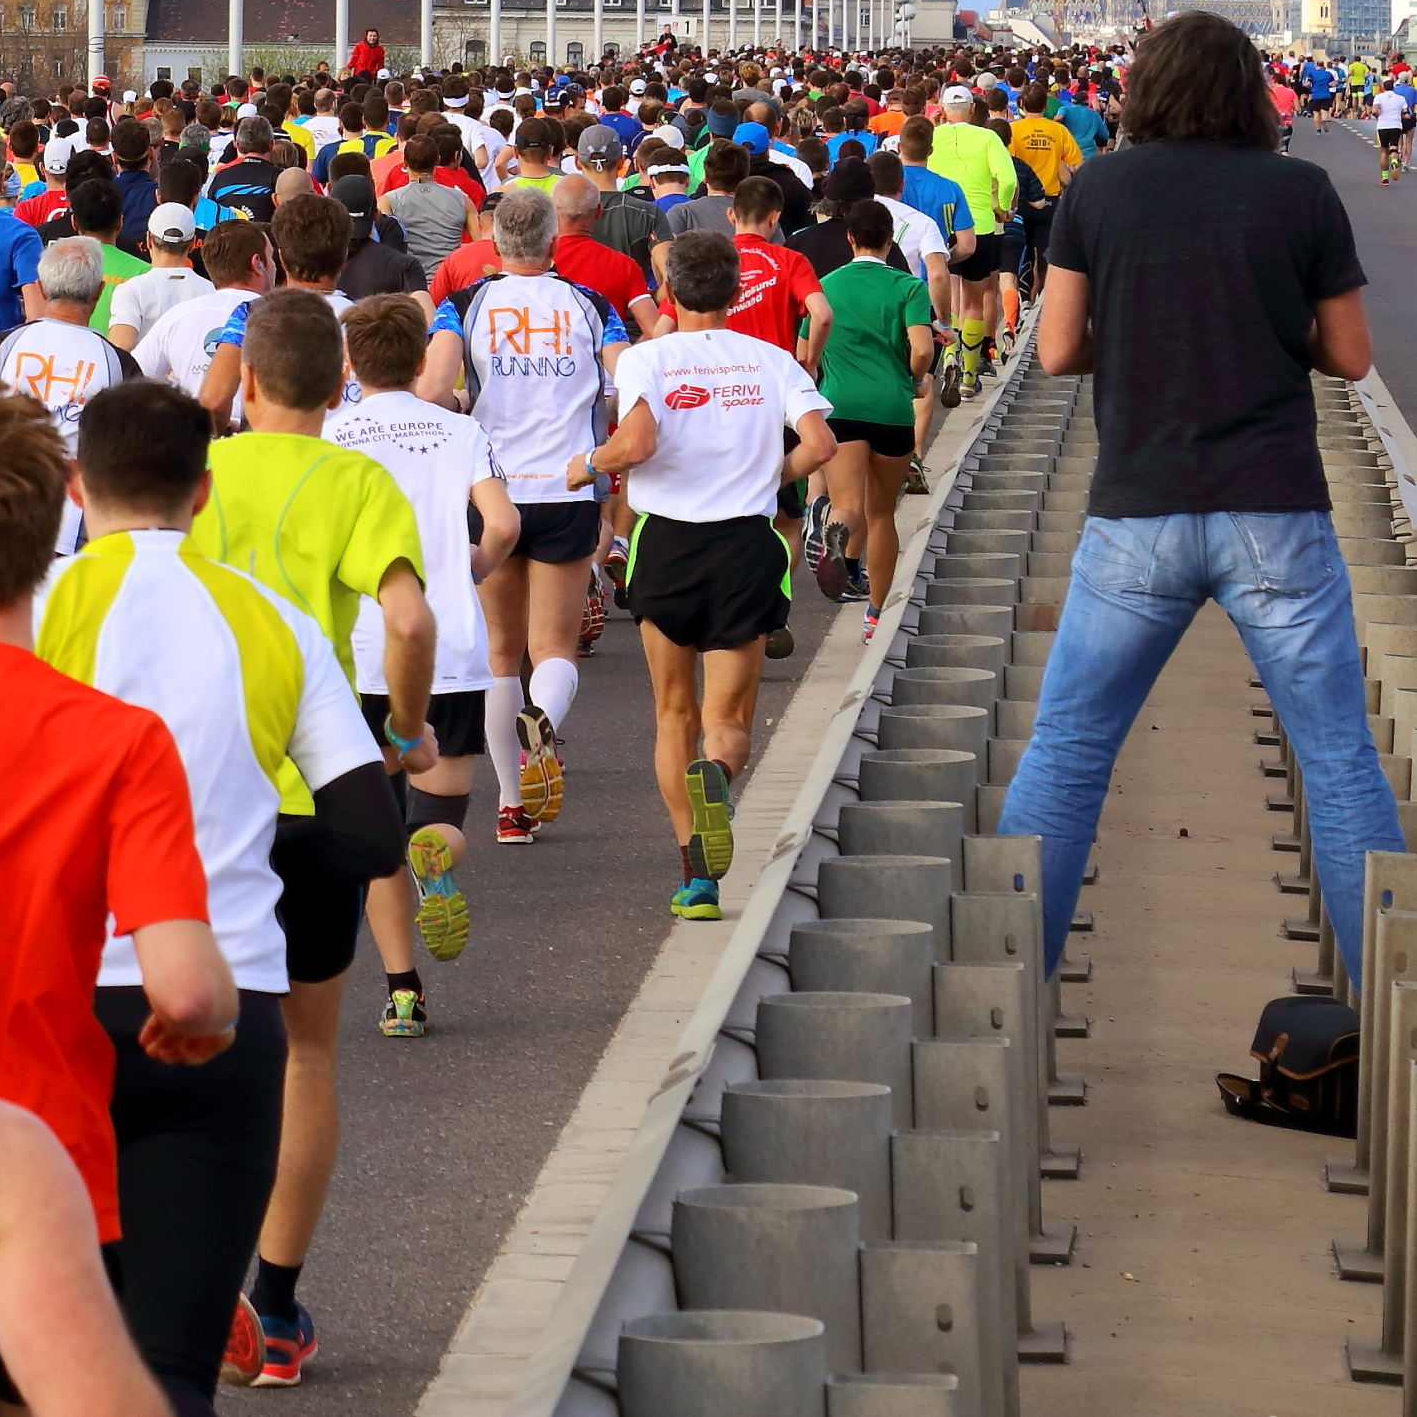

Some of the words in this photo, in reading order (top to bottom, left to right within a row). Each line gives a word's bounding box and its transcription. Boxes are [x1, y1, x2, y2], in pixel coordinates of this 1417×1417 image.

[491, 356, 576, 378] RUNNING
[663, 363, 761, 379] www.ferivisport.hr
[712, 384, 761, 398] FERIVI
[720, 396, 766, 412] sport
[335, 432, 356, 443] WE
[359, 424, 385, 437] ARE
[390, 421, 444, 433] EUROPE
[372, 433, 392, 443] CITY
[394, 430, 445, 440] MARATHON
